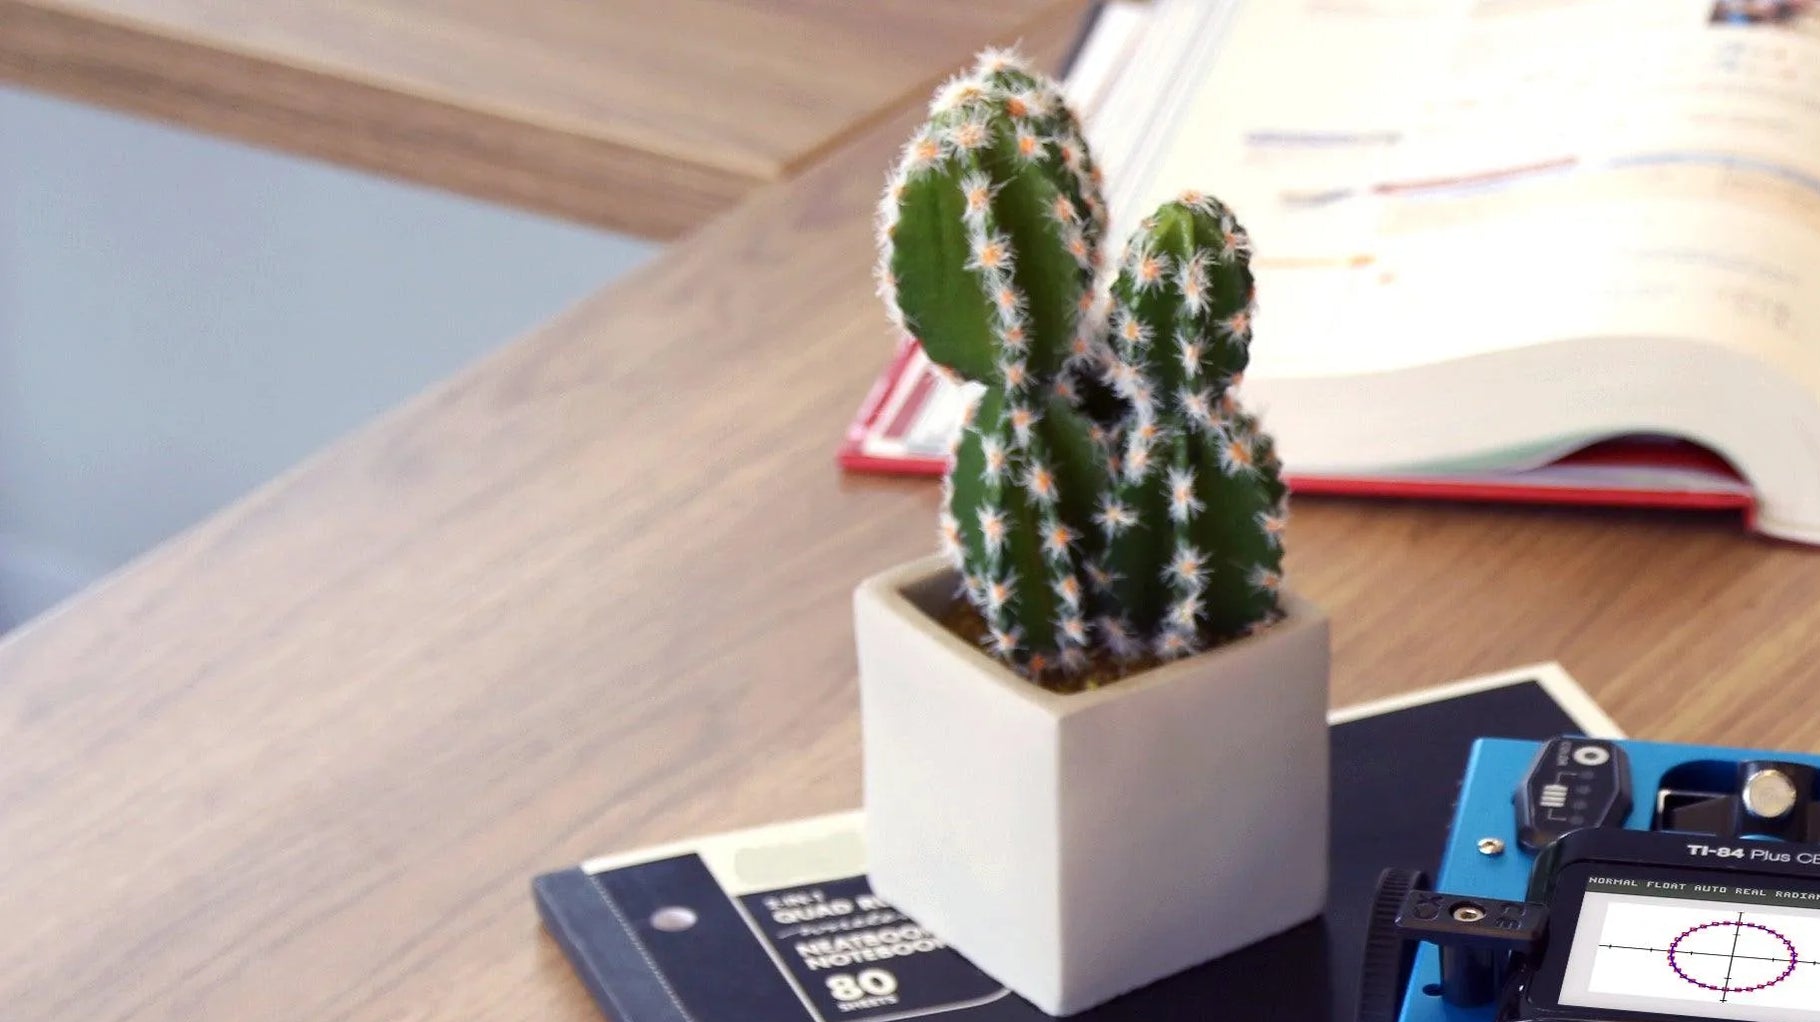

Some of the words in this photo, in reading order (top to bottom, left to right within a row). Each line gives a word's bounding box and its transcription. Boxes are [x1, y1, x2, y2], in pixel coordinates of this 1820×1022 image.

[1687, 844, 1744, 859] TI-84
[1751, 849, 1790, 864] Plus
[1589, 876, 1638, 887] NORMAL
[1646, 880, 1686, 890] FLOAT
[1694, 884, 1727, 893] AUTO
[1735, 887, 1767, 896] REAL
[825, 968, 898, 1001] 80
